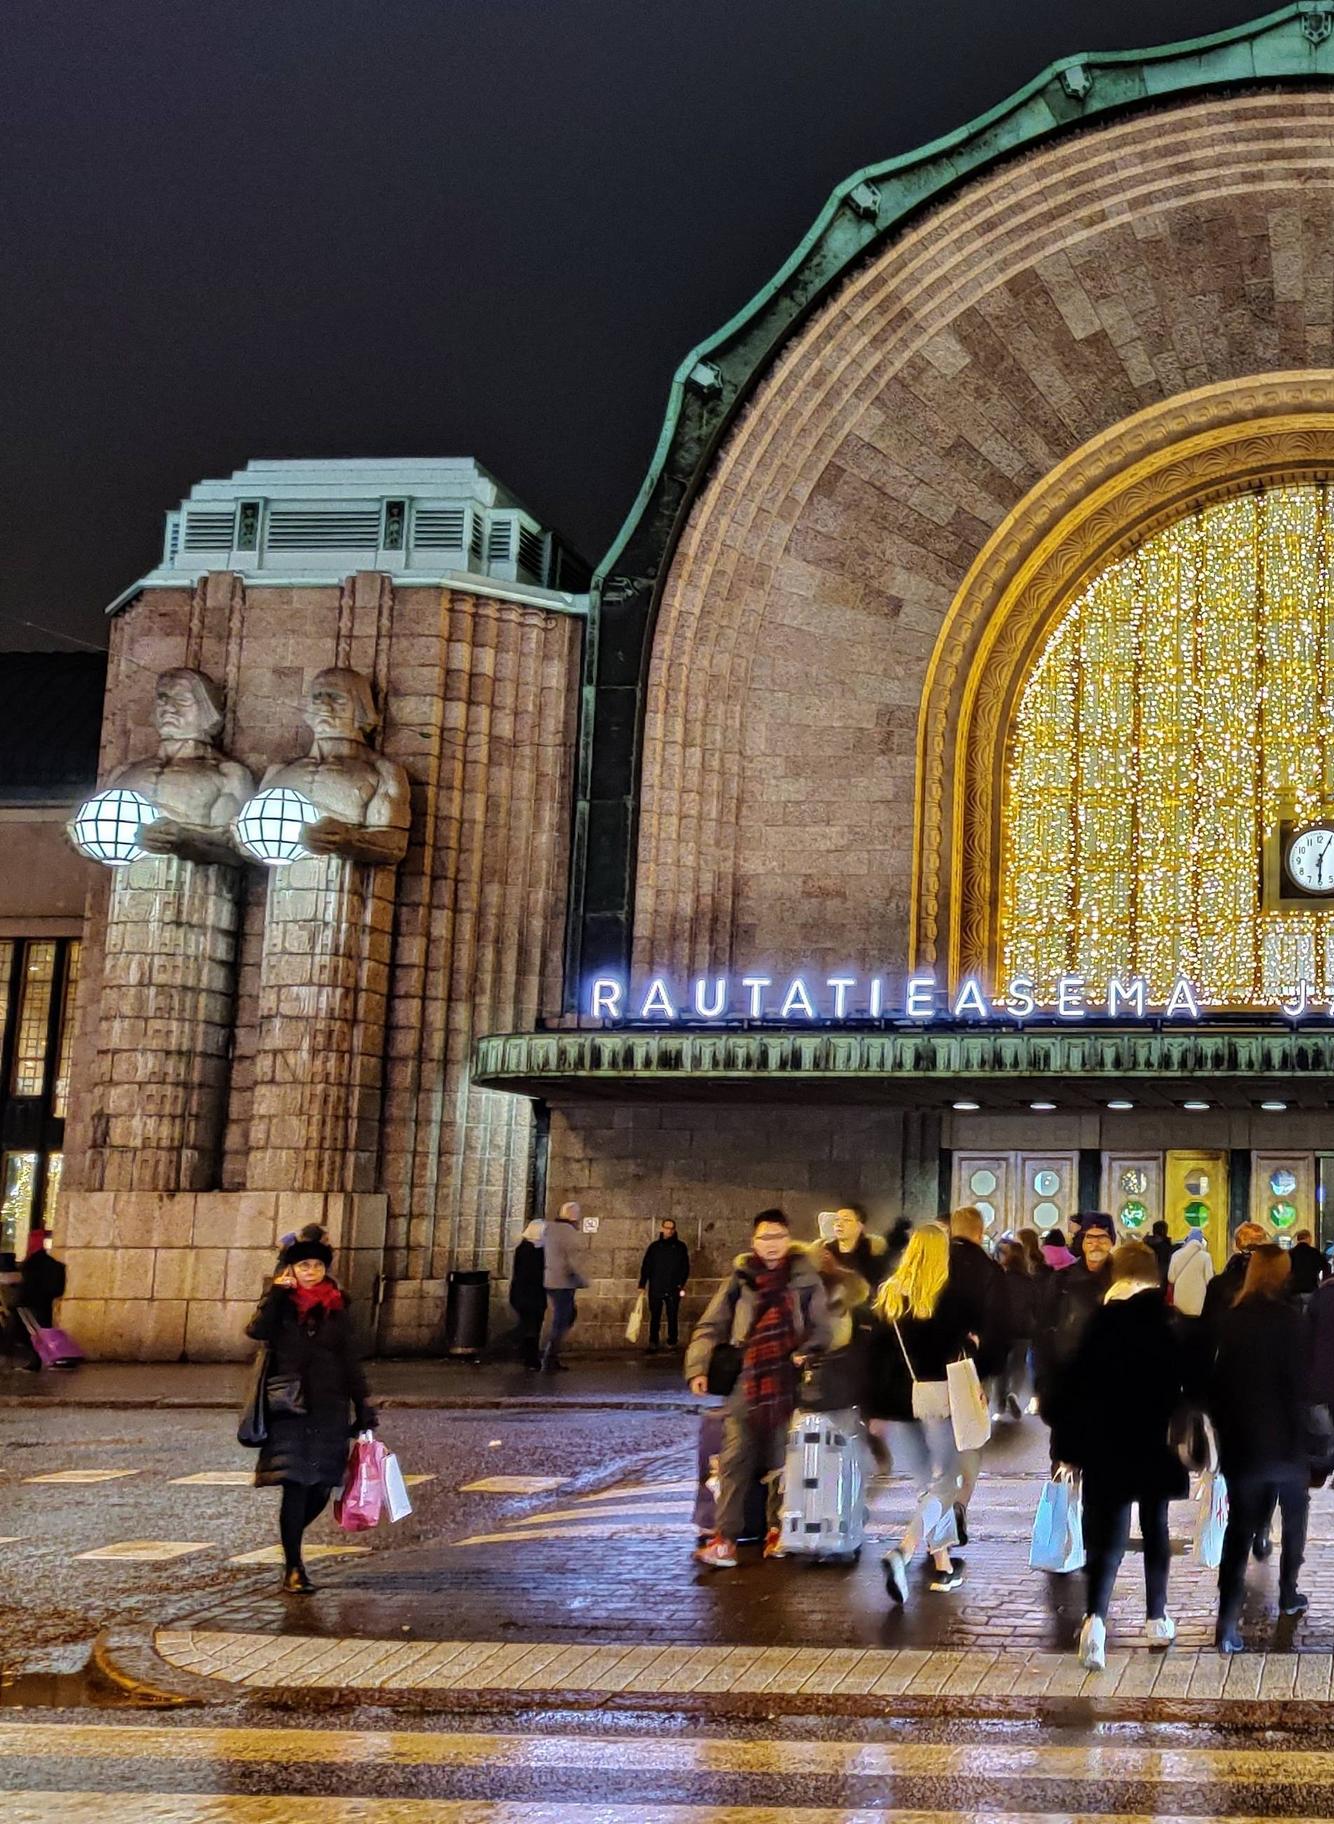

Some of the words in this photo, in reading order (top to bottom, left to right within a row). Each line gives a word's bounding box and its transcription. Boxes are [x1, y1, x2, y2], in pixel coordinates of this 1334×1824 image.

[1306, 837, 1313, 847] 11
[1317, 835, 1324, 844] 12
[1298, 846, 1306, 855] 10
[1295, 856, 1302, 865] 9
[1299, 867, 1305, 876] 8
[1306, 875, 1312, 884] 7
[1328, 875, 1334, 884] 5
[591, 977, 1199, 1019] RAUTATIEASEMA
